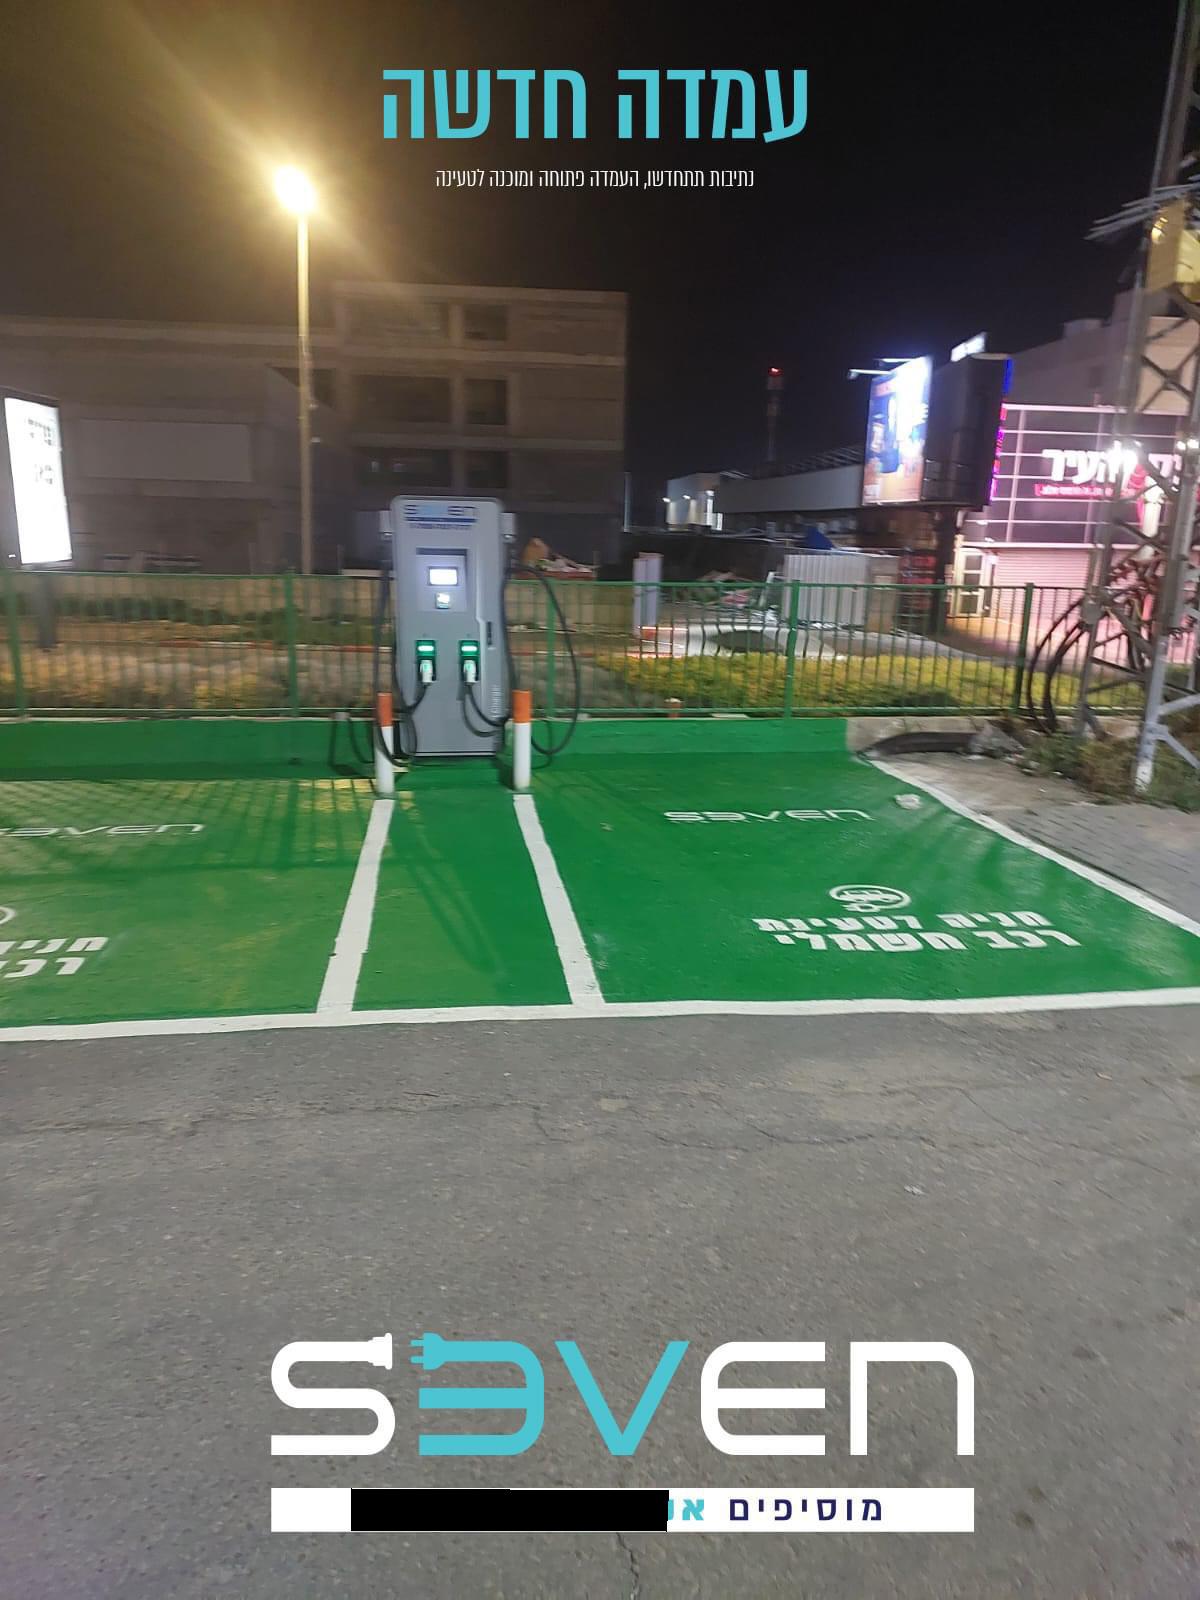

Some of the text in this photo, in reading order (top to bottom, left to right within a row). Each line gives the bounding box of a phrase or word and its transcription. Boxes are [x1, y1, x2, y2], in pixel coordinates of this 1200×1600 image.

[936, 911, 1053, 929] חניה
[766, 929, 1082, 952] רכב חשמלי
[0, 956, 85, 978] רכ
